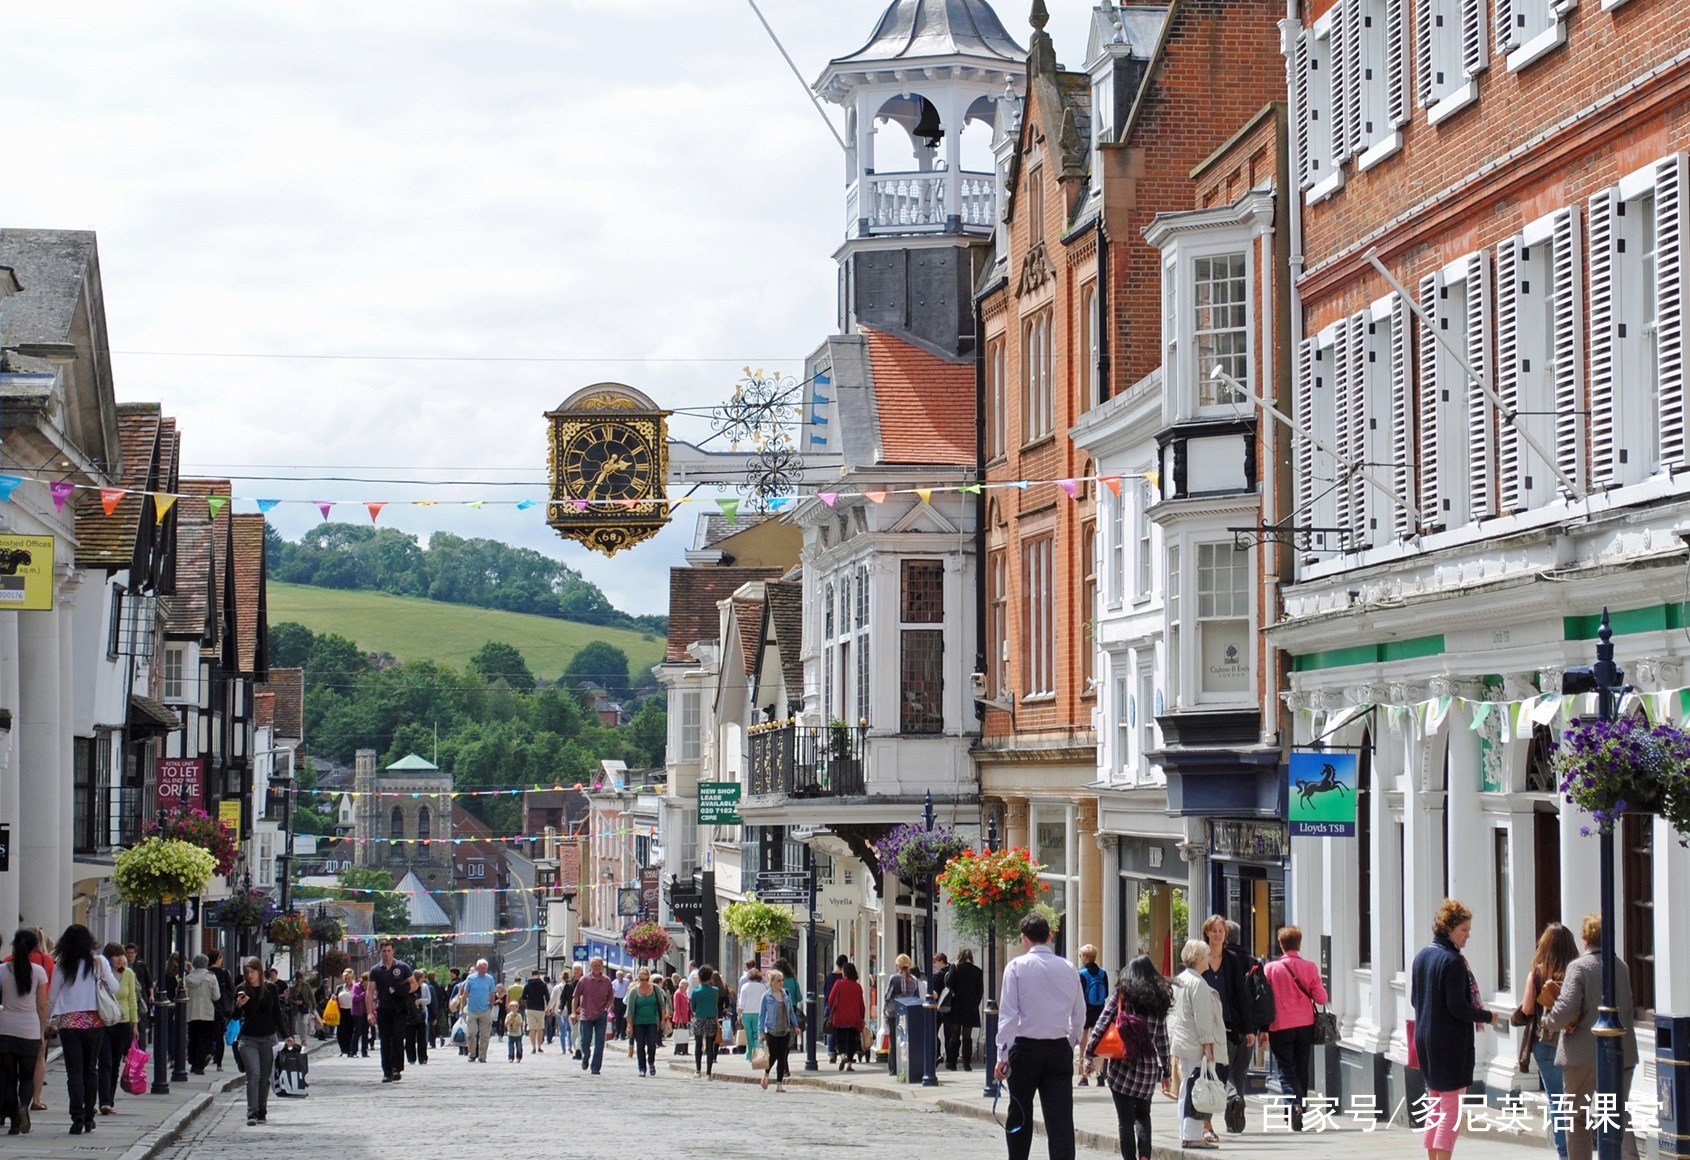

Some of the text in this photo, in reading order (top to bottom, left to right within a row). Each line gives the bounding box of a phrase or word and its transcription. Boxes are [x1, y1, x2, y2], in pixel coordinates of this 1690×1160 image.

[26, 540, 52, 548] Offices
[598, 533, 622, 544] 1683
[161, 766, 199, 777] TO LET
[1299, 822, 1345, 835] Lloyds TSB
[829, 897, 853, 907] Viyella
